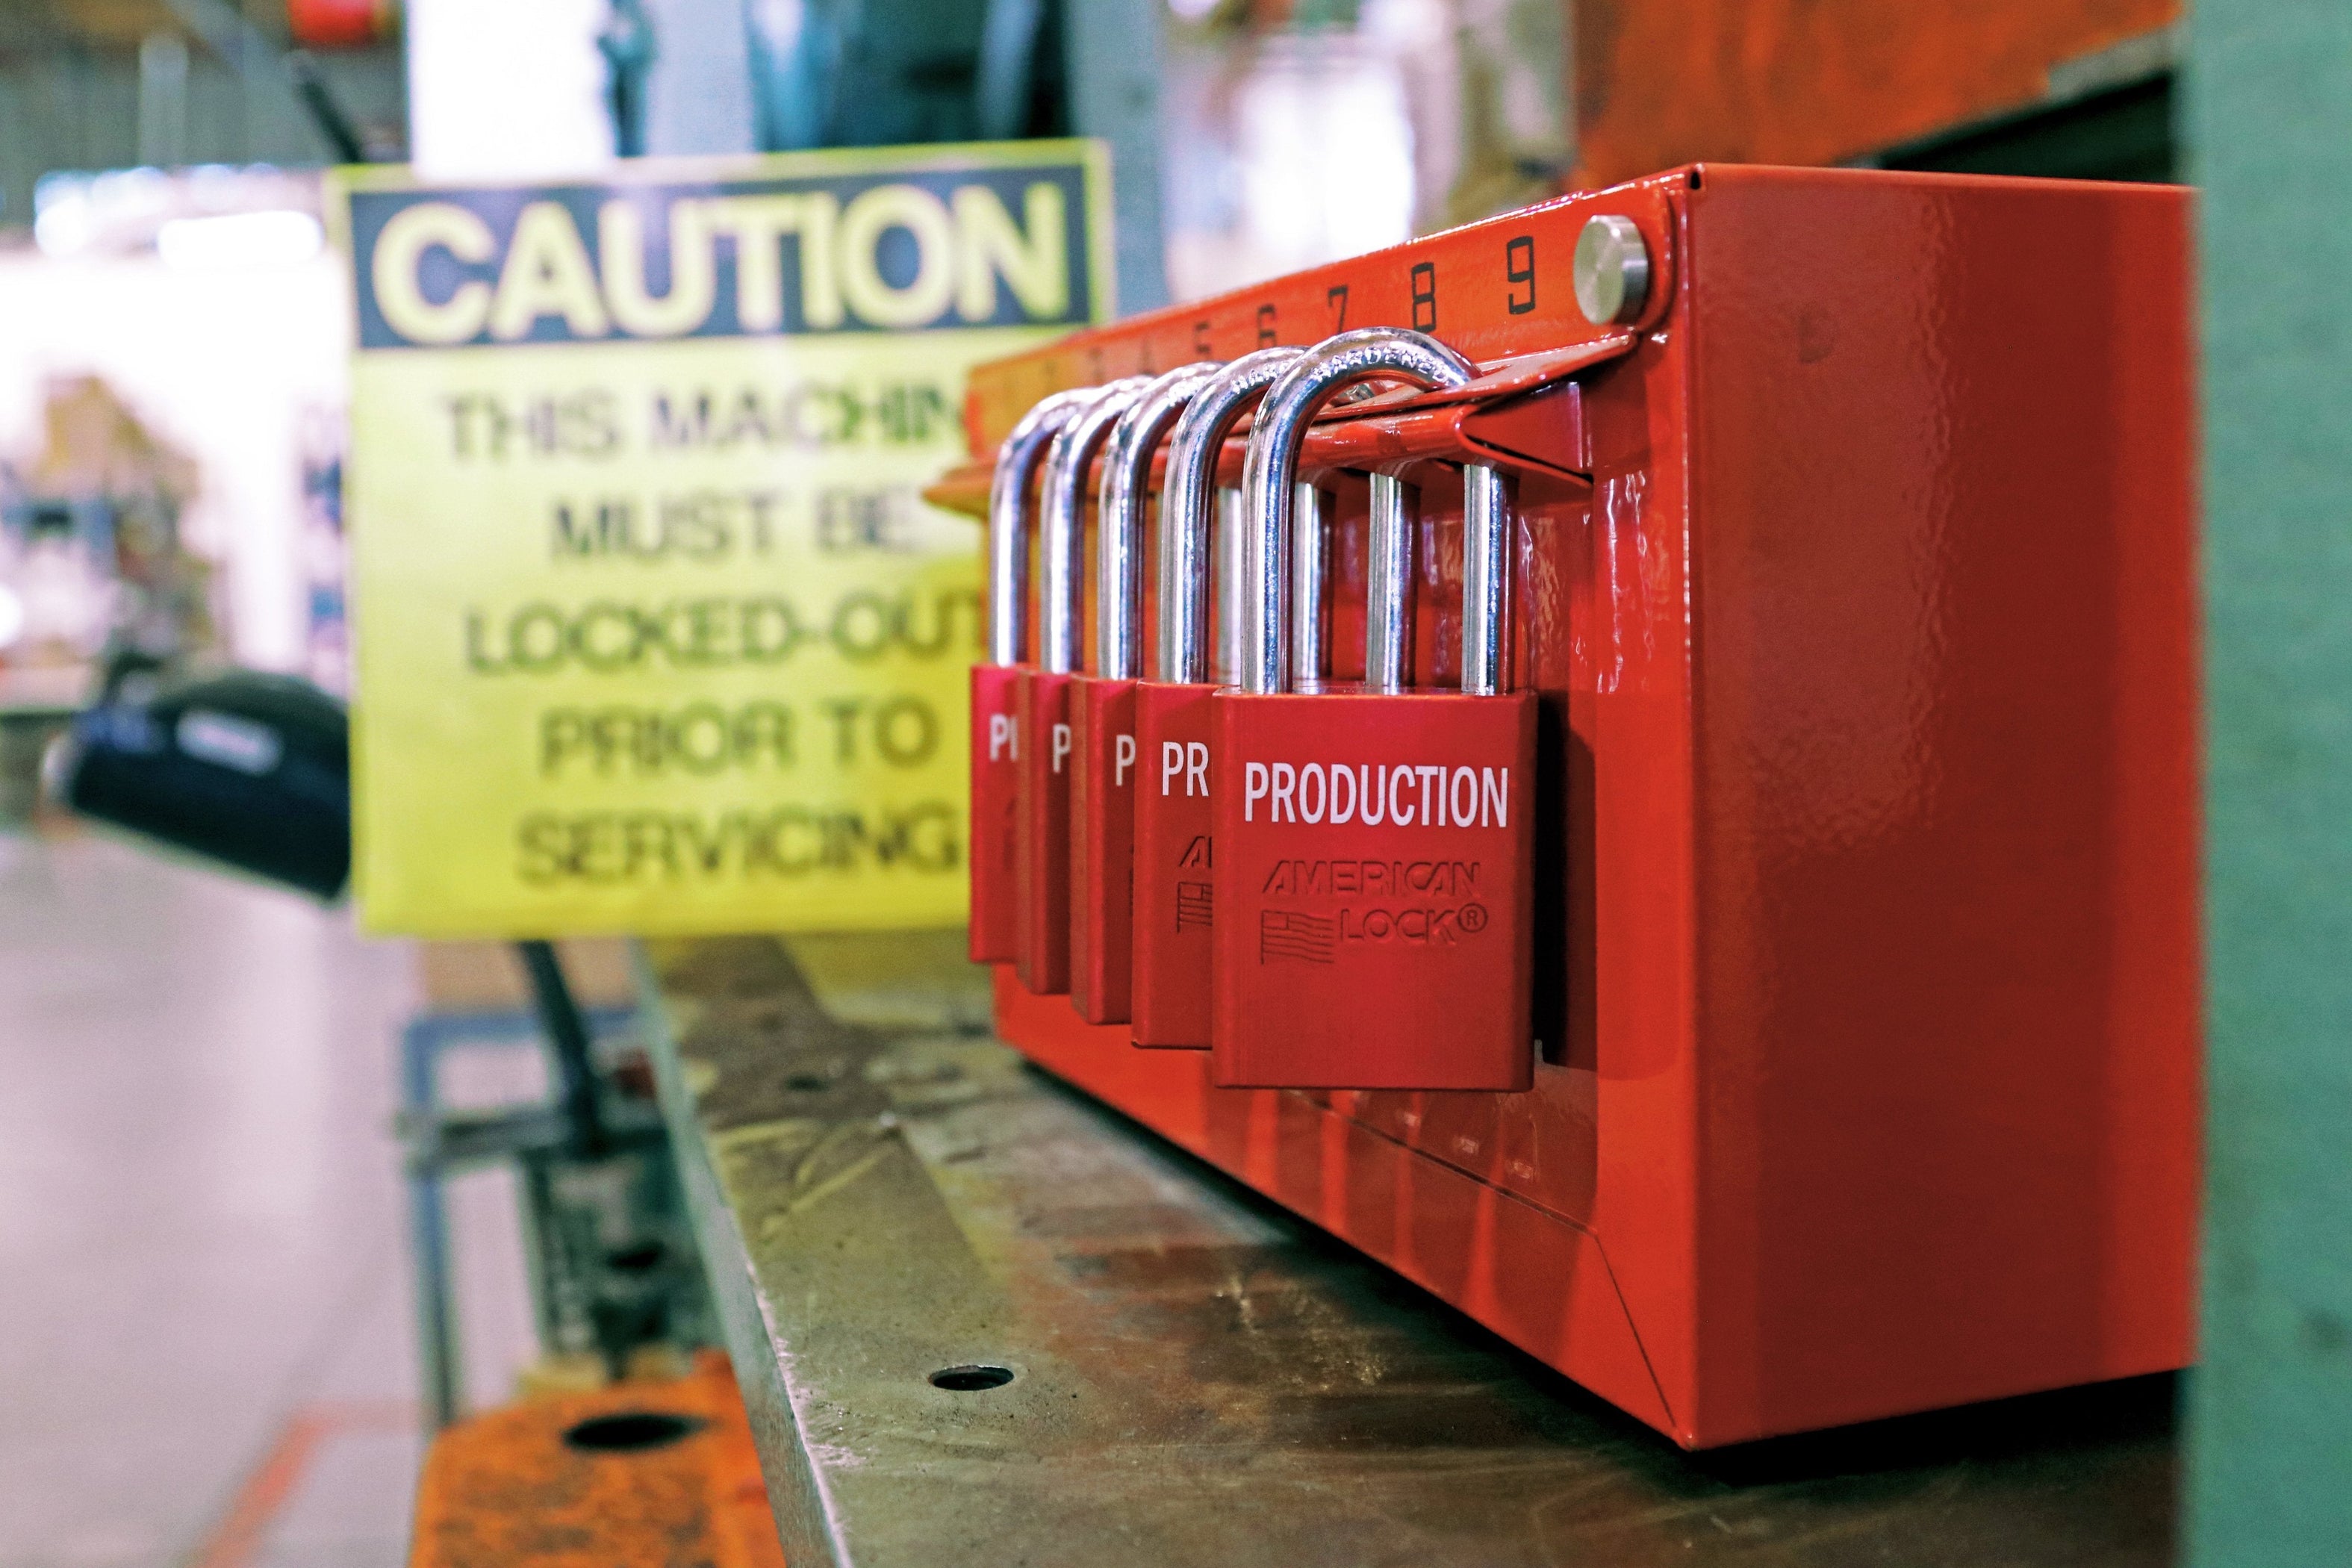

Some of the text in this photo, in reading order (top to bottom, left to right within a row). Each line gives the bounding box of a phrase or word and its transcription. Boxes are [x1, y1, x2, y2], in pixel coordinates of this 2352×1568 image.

[371, 181, 1067, 345] CAUTION
[1257, 303, 1277, 349] 6
[1327, 284, 1348, 334] 7
[1411, 262, 1437, 335] 8
[1506, 235, 1536, 315] 9
[442, 380, 966, 464] THIS MACHIN
[548, 485, 927, 567] MUST BE
[538, 694, 797, 779] PRIOR
[818, 691, 942, 769] TO
[1244, 762, 1509, 828] PRODUCTION
[514, 797, 960, 889] SERVICING
[1262, 860, 1481, 897] AMERICAN
